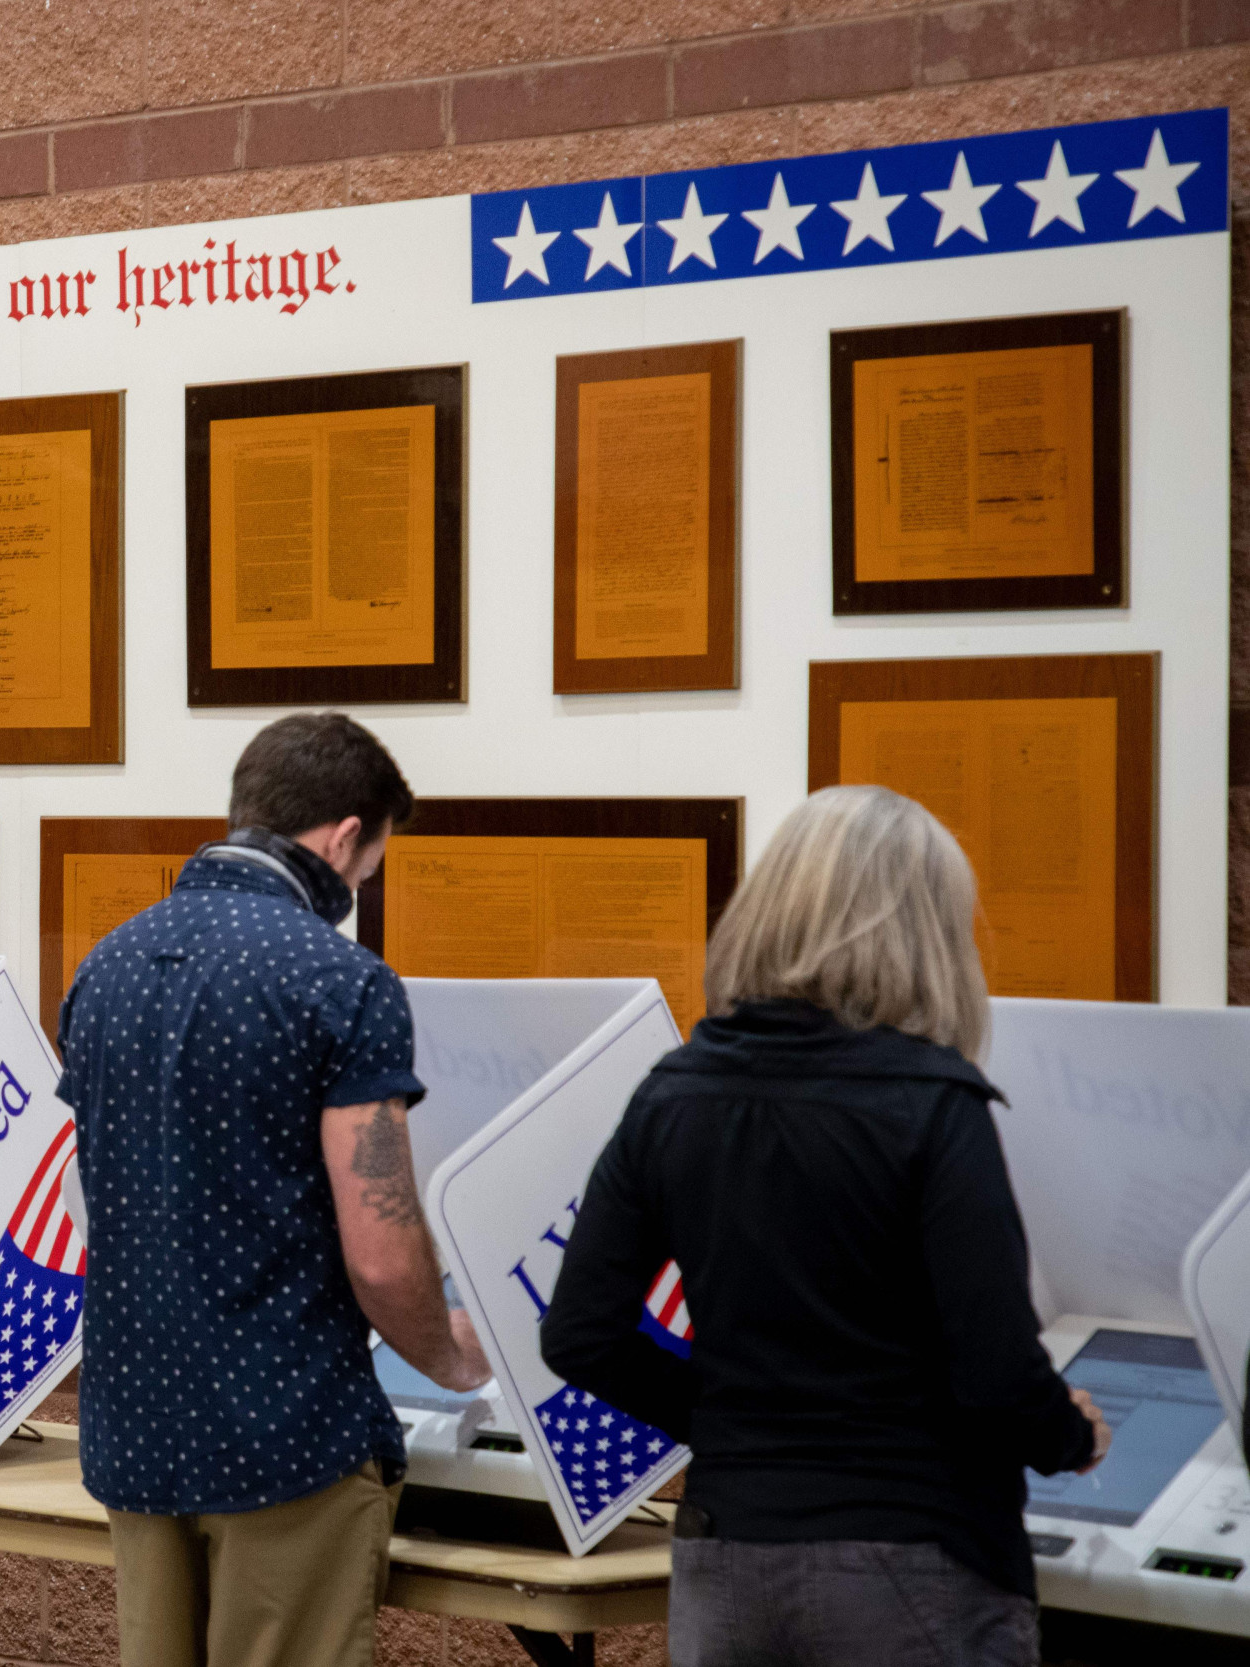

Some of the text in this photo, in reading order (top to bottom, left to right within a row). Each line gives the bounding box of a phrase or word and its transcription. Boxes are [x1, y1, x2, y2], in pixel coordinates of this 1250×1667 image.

[7, 269, 97, 322] our
[114, 237, 357, 326] heritage.
[508, 1255, 550, 1323] I
